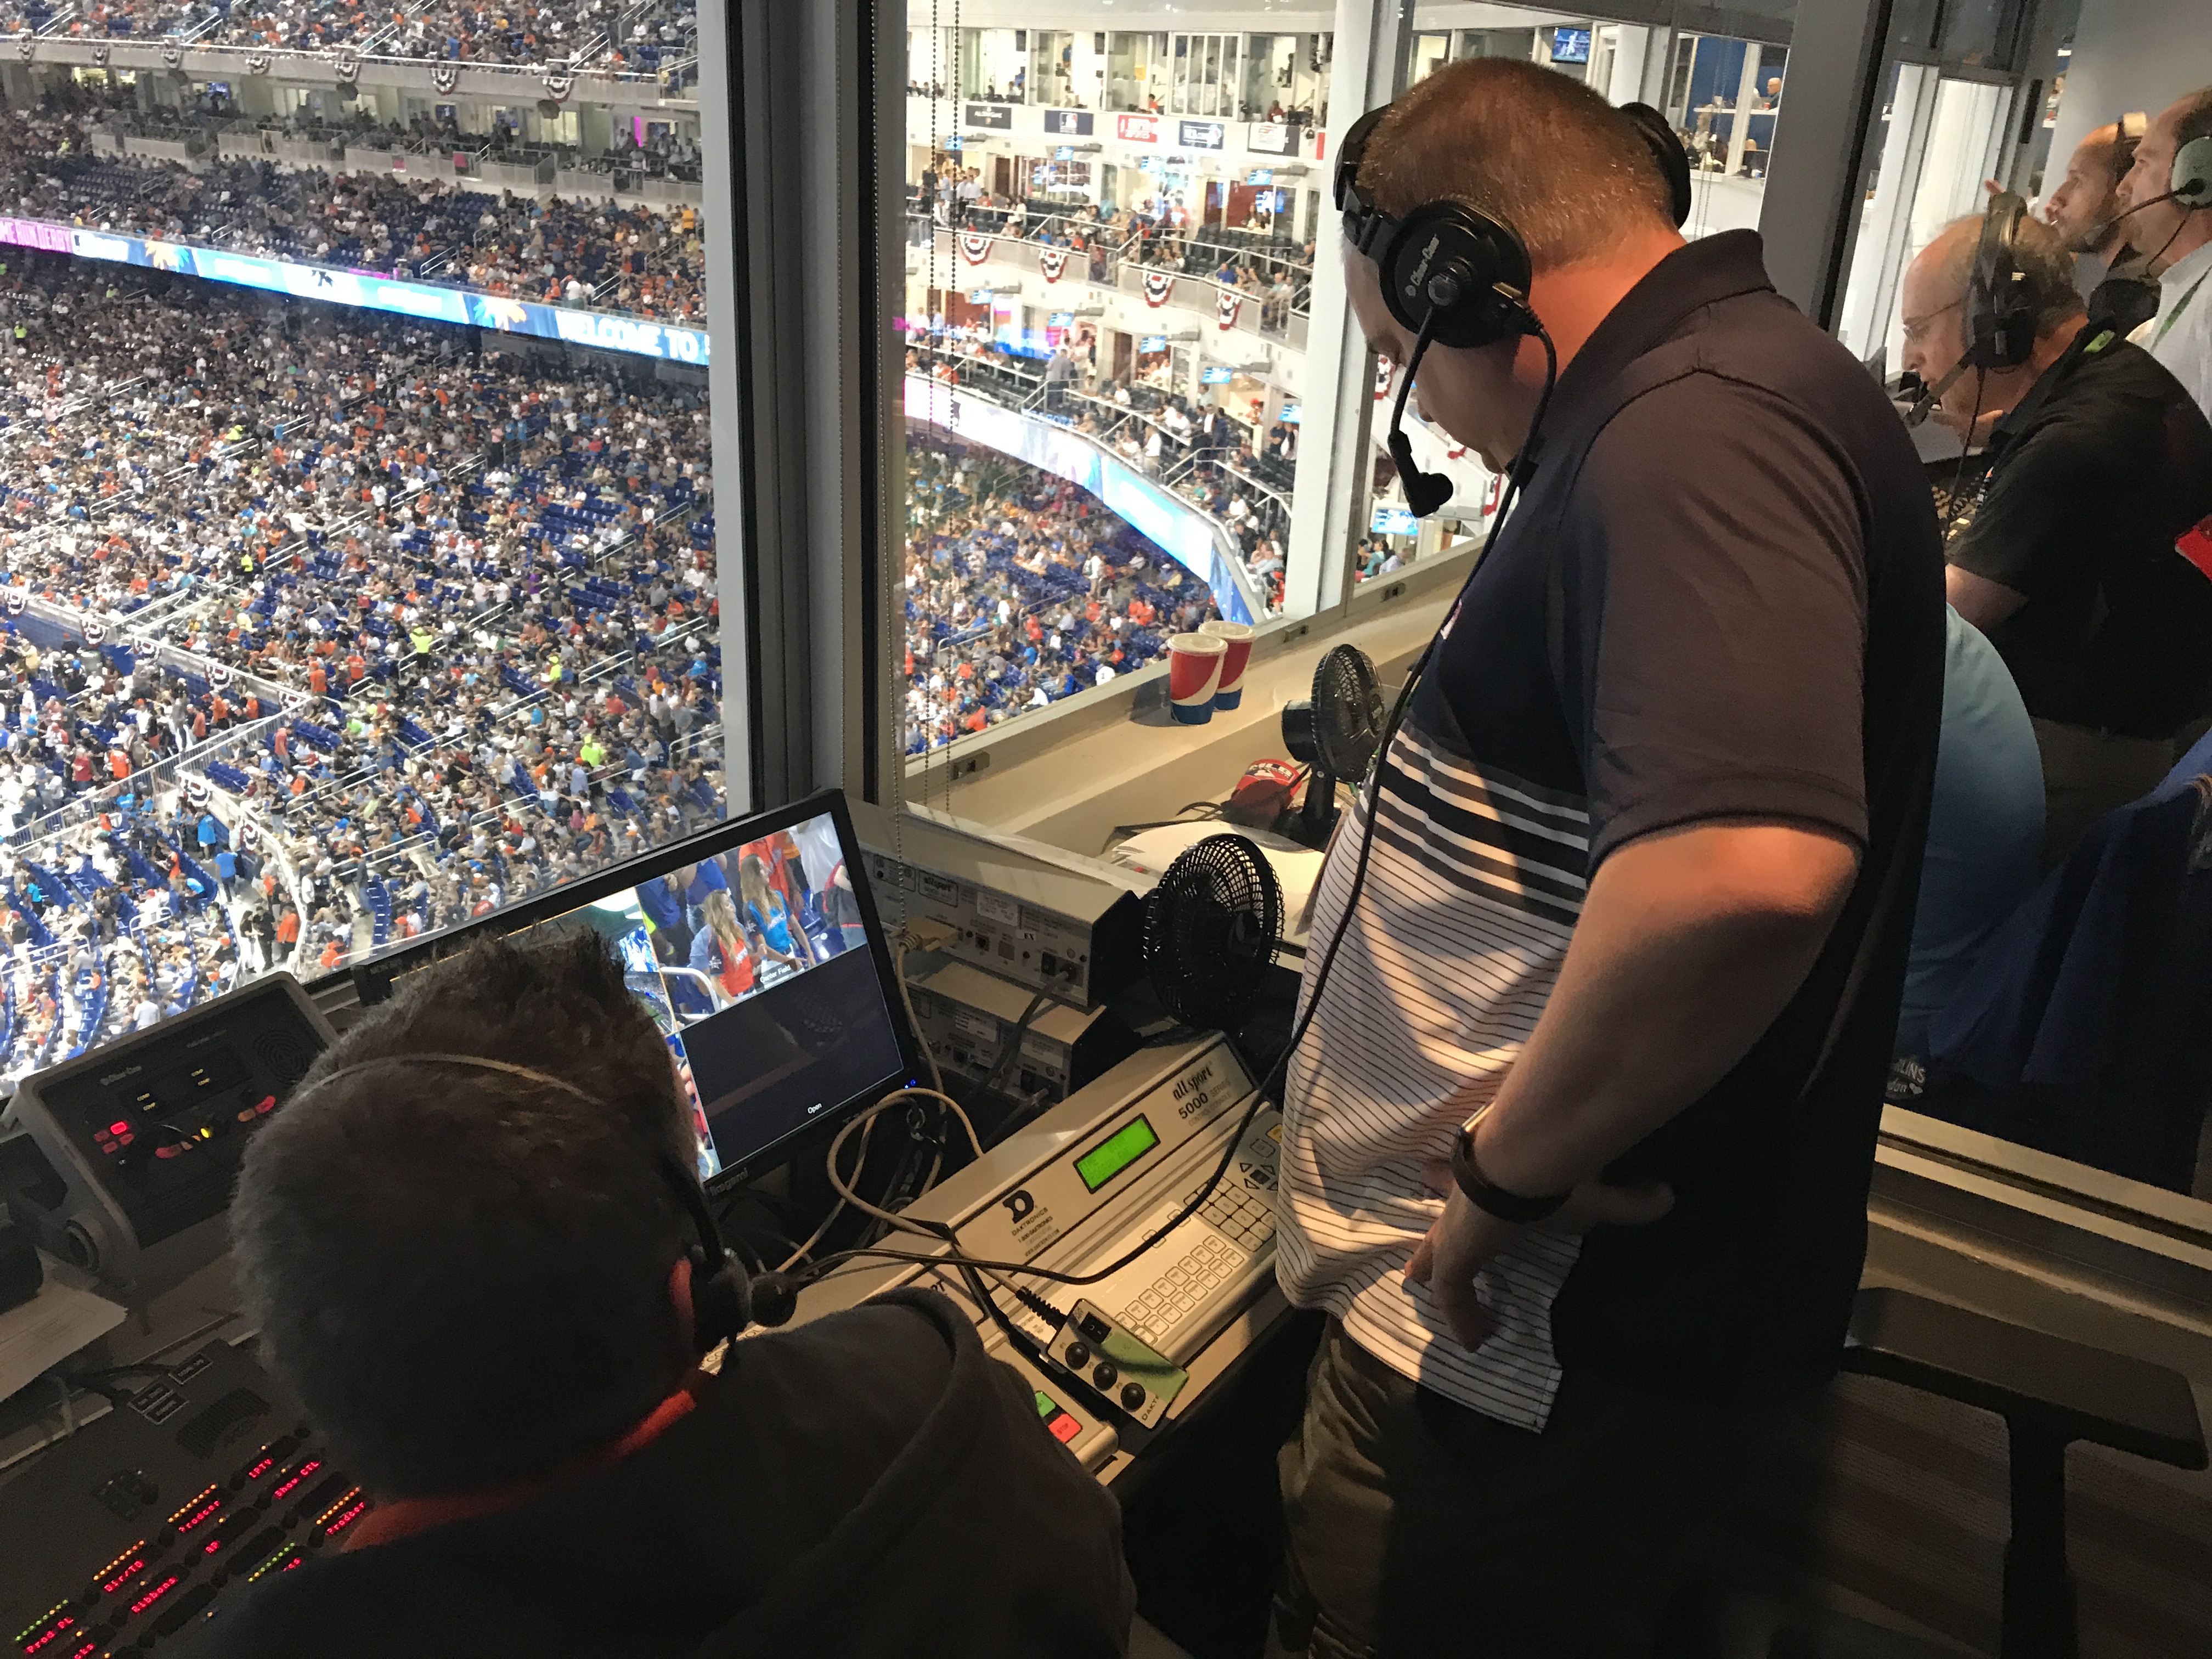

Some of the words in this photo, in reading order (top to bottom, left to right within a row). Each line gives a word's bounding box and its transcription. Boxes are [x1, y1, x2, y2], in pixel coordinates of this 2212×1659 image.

[555, 310, 663, 356] WELCOME
[664, 329, 699, 362] TO
[808, 1103, 822, 1114] Open
[1178, 1093, 1209, 1119] 5000
[1210, 1077, 1231, 1098] SERIES
[1012, 1207, 1048, 1237] DAKTRONICS
[1057, 1423, 1068, 1434] STOP
[131, 1577, 177, 1613] Ribbons
